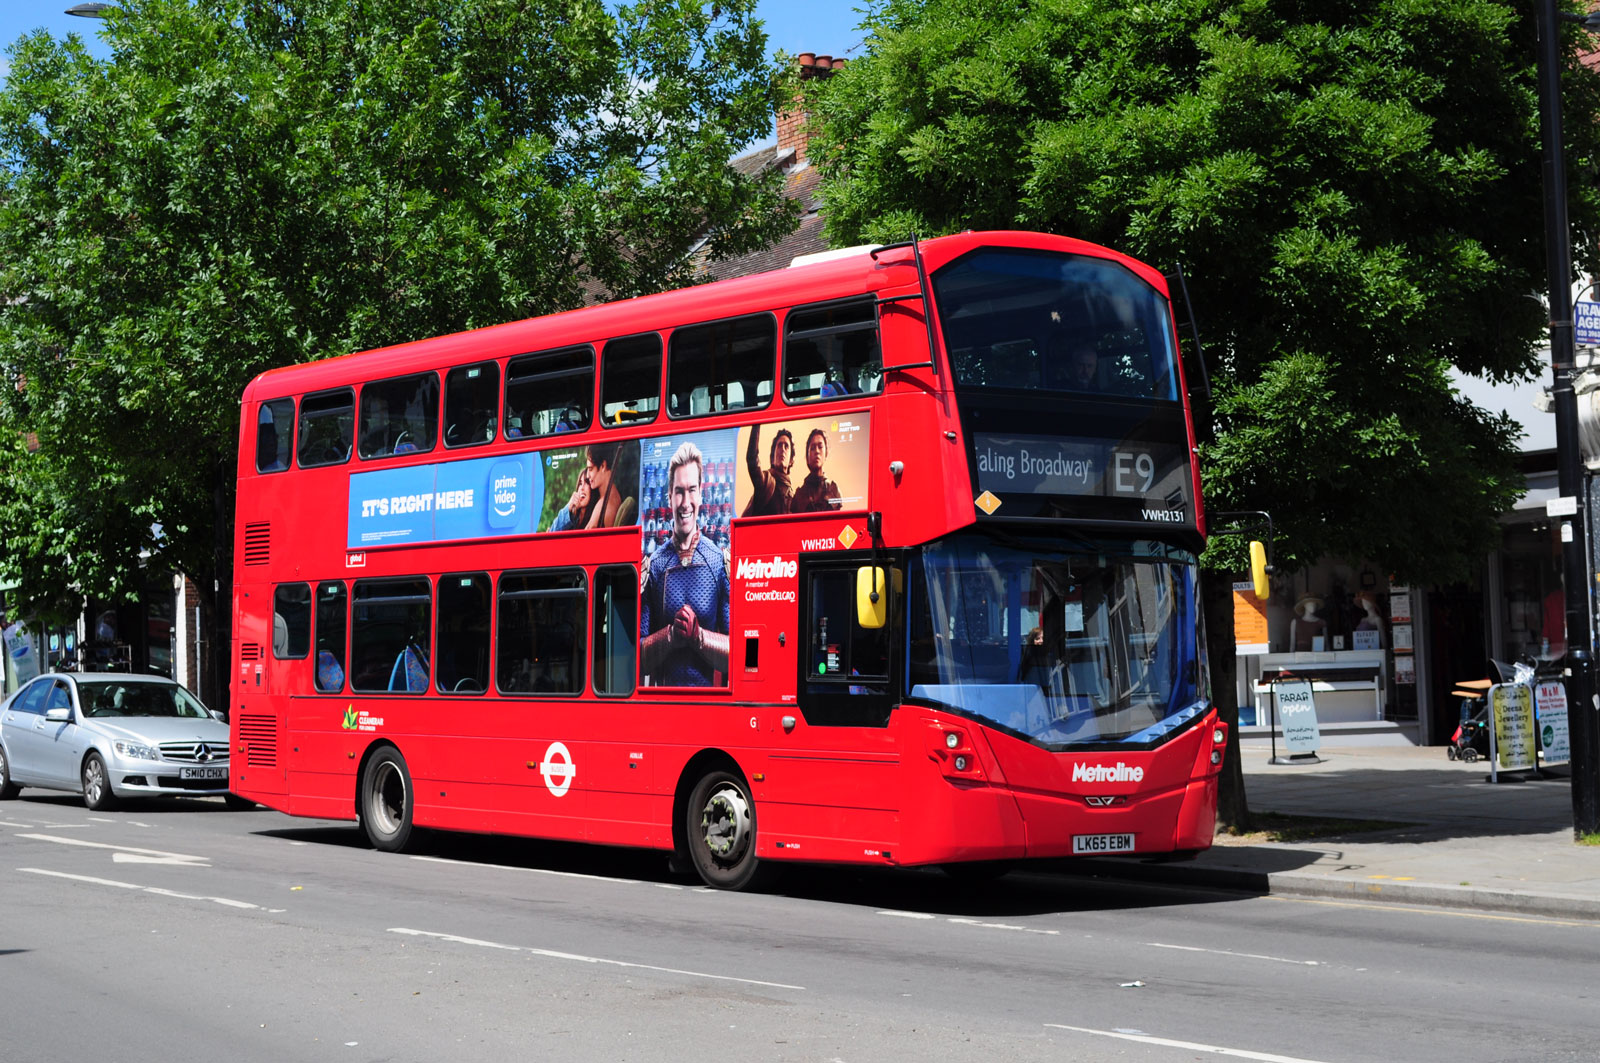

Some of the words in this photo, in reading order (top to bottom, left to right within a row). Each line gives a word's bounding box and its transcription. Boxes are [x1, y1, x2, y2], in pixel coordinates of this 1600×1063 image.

[976, 447, 1015, 480] aling
[1020, 449, 1090, 485] Broadway
[1115, 452, 1155, 493] E9
[494, 475, 517, 491] prime
[361, 498, 389, 517] IT'S
[390, 493, 433, 515] RIGHT
[435, 489, 474, 510] HERE
[494, 491, 517, 504] video
[1142, 508, 1185, 522] VWH2131
[801, 538, 836, 550] VWH2131
[736, 556, 798, 580] Metroline
[1542, 687, 1548, 697] M
[1553, 686, 1559, 695] M
[1282, 703, 1311, 717] open
[750, 717, 757, 728] G
[185, 768, 205, 778] SM10
[206, 768, 223, 778] CHX
[1072, 761, 1144, 782] Metroline
[1077, 836, 1107, 851] LK65
[1109, 835, 1131, 850] EBM
